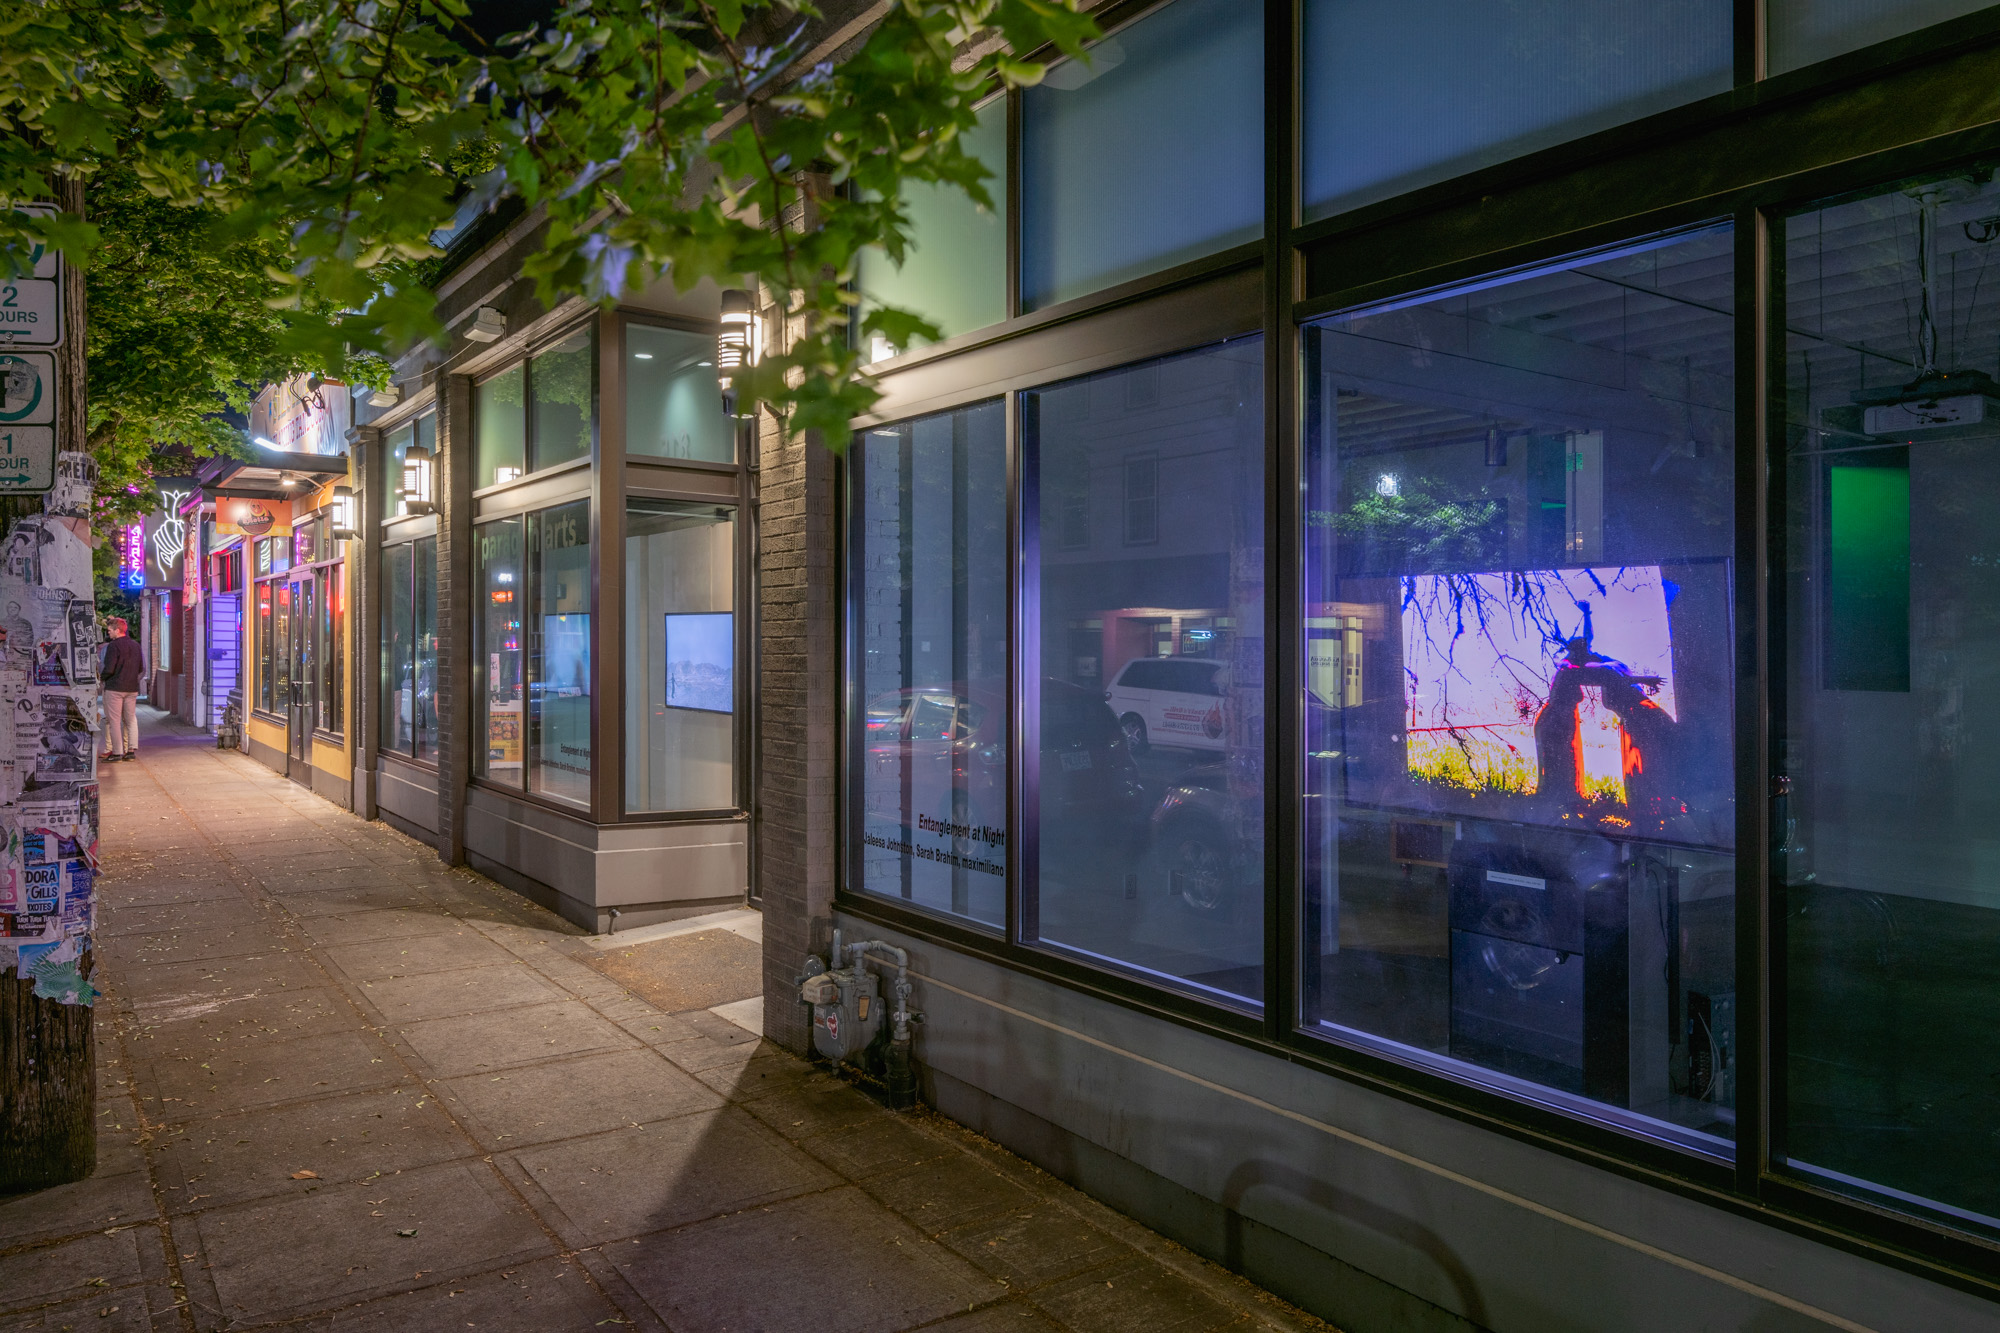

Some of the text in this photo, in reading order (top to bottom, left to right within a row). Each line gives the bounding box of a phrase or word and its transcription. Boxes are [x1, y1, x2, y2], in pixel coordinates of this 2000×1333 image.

[2, 286, 18, 307] 2
[2, 433, 12, 454] 1
[545, 513, 577, 550] arts
[918, 814, 1005, 848] Entanglement at Night
[864, 831, 1004, 877] Jaleesa Johnston, Sarah Brahim, maximiliano
